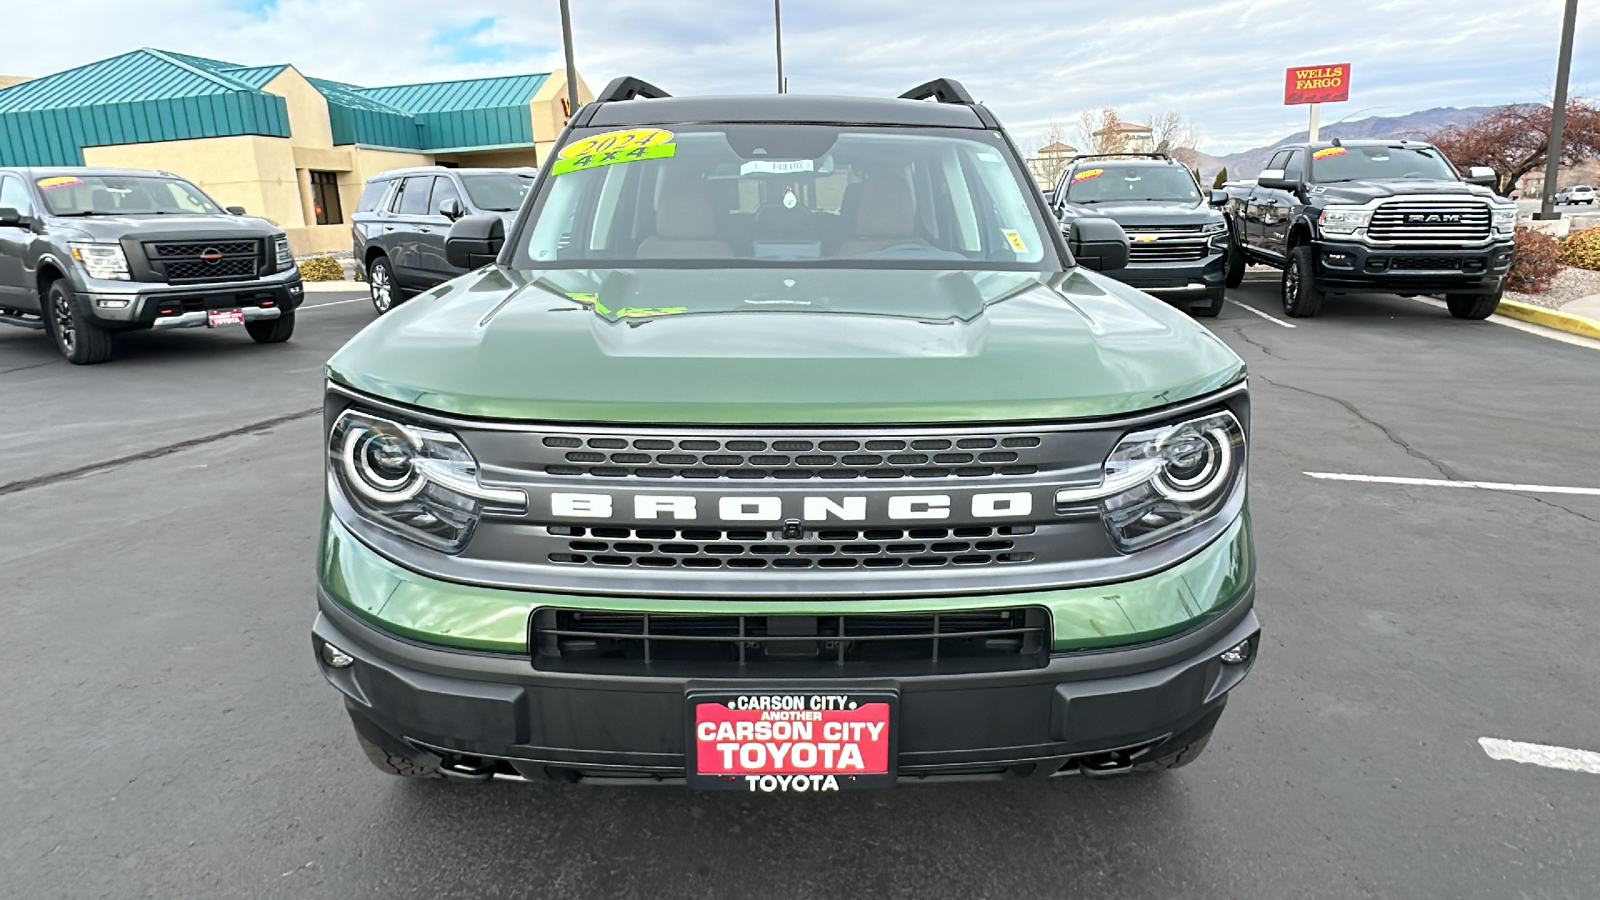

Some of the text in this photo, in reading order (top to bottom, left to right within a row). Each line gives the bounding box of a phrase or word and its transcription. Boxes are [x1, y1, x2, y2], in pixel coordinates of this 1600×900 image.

[1296, 67, 1343, 79] WELLS
[1296, 77, 1341, 90] FARGO
[574, 131, 659, 158] 2024
[1408, 214, 1460, 222] RAM
[551, 491, 1033, 521] BRONCO
[737, 695, 848, 710] CARSON CITY
[760, 711, 823, 721] ANOTHER
[697, 721, 886, 741] CARSON CITY
[716, 742, 866, 769] TOYOTA
[745, 775, 840, 792] TOYOTA
